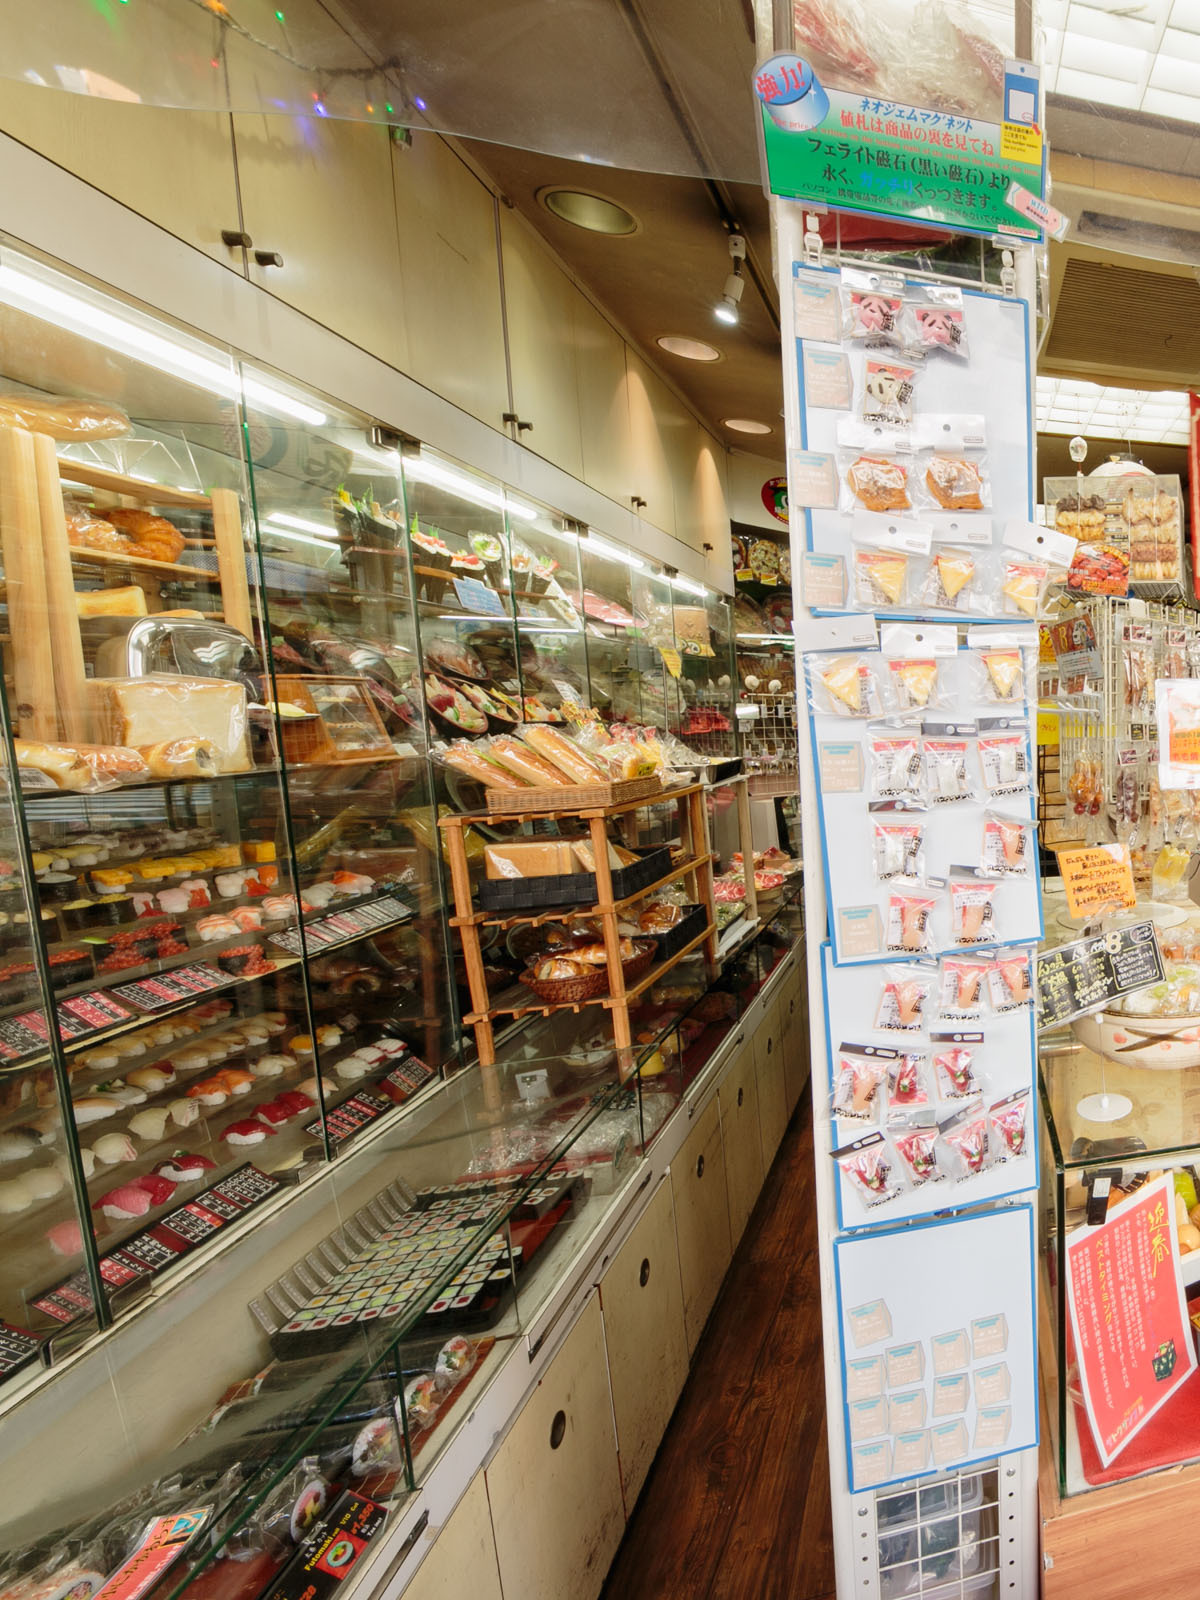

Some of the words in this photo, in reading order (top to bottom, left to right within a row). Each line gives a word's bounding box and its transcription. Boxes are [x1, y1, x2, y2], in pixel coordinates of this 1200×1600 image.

[840, 109, 994, 157] 値札は商品の裏を見てね
[1148, 1201, 1170, 1278] 迎春
[303, 1534, 334, 1572] Futomaki
